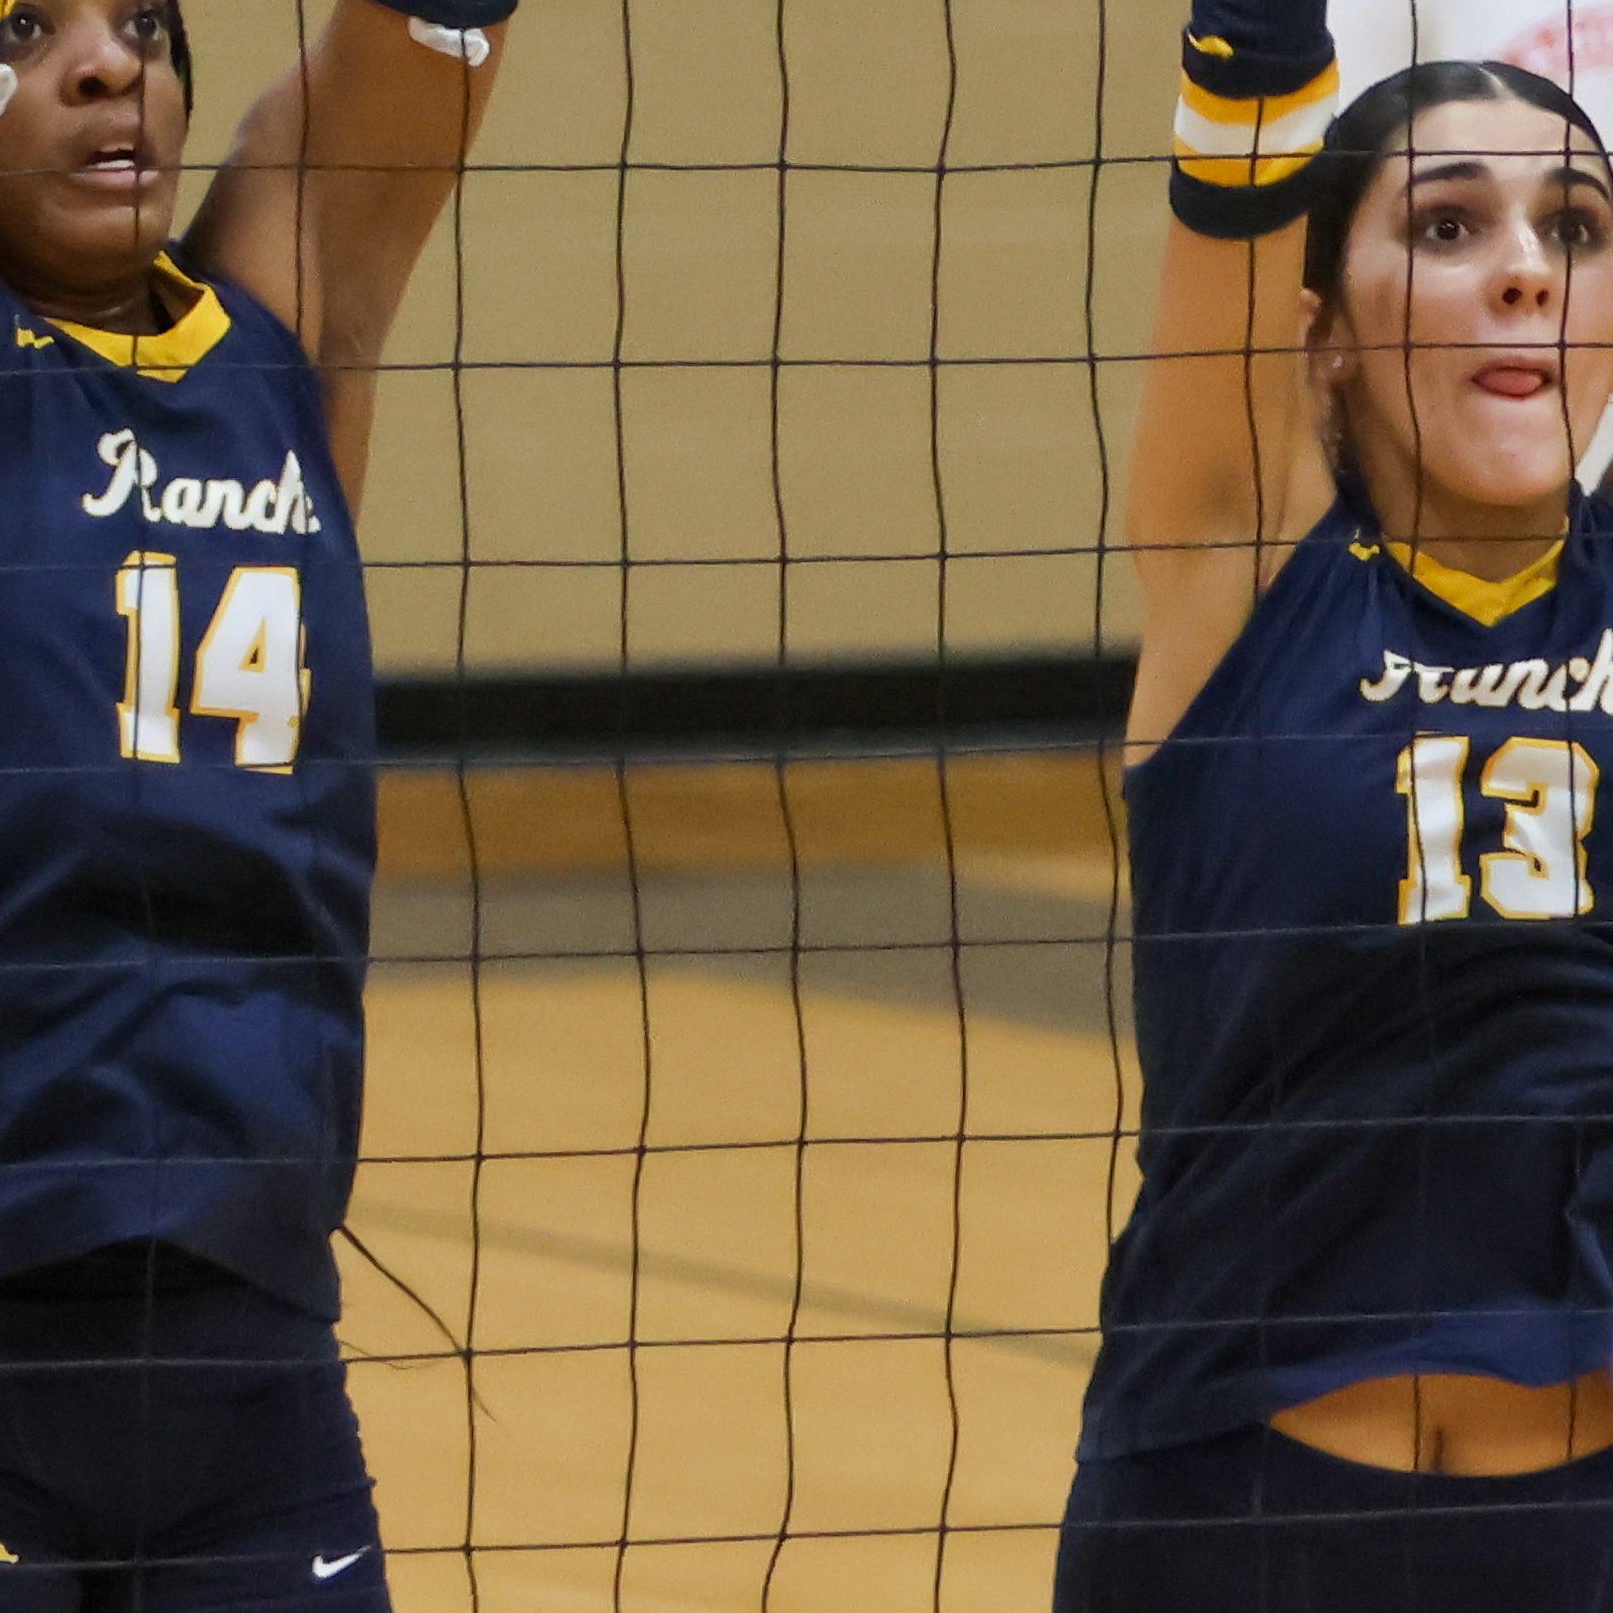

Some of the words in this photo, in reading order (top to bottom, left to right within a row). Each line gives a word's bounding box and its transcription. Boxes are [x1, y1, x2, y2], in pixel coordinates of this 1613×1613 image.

[82, 428, 322, 535] Ranch
[115, 550, 312, 775] 14
[1394, 730, 1600, 926] 13
